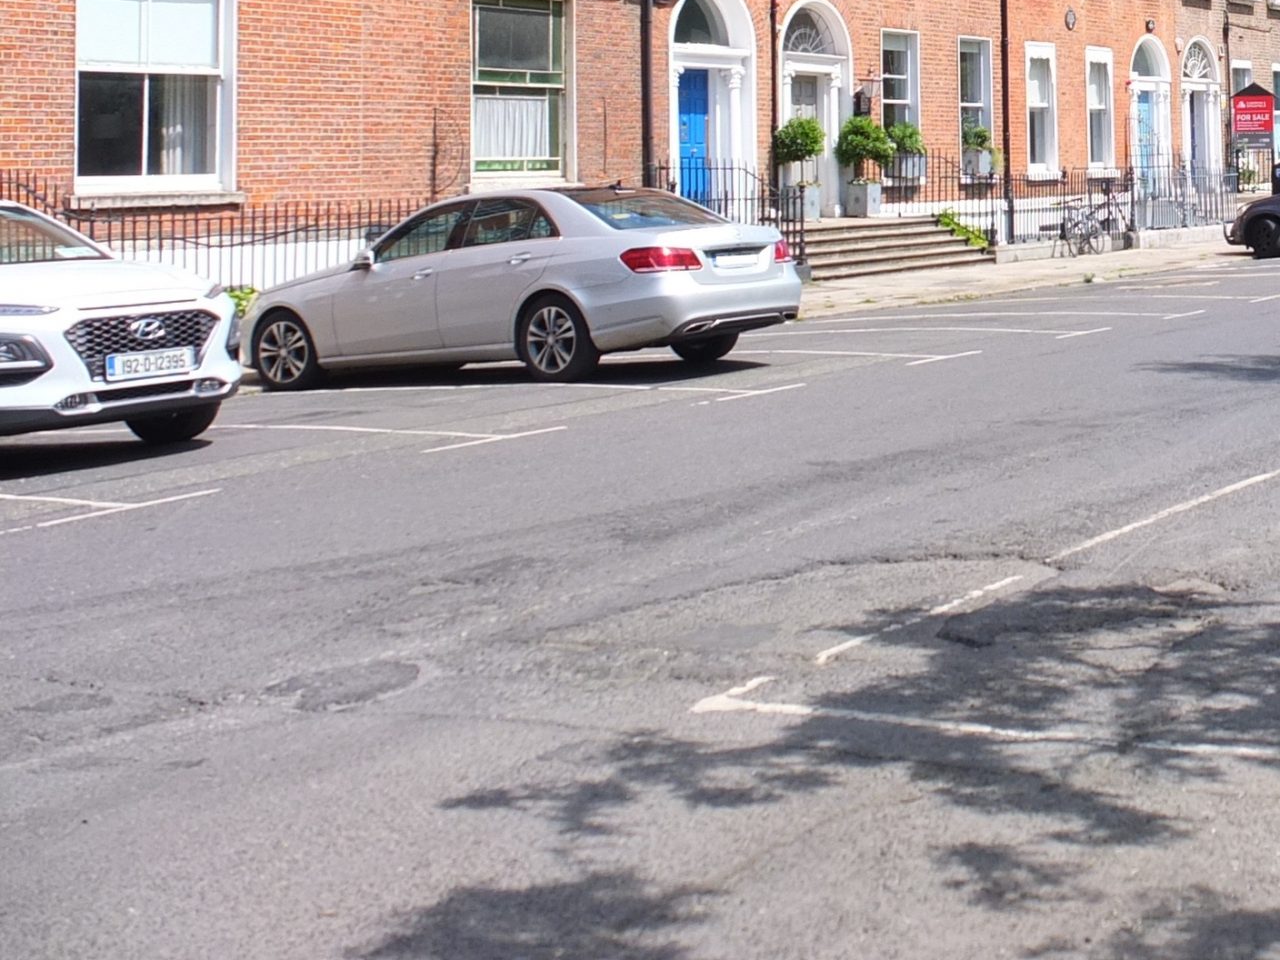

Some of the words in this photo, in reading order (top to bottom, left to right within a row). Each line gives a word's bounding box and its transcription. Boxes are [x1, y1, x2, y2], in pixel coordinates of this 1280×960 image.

[1236, 113, 1251, 121] FOR
[1252, 113, 1270, 121] SALE
[122, 353, 186, 375] 192-D-12395
